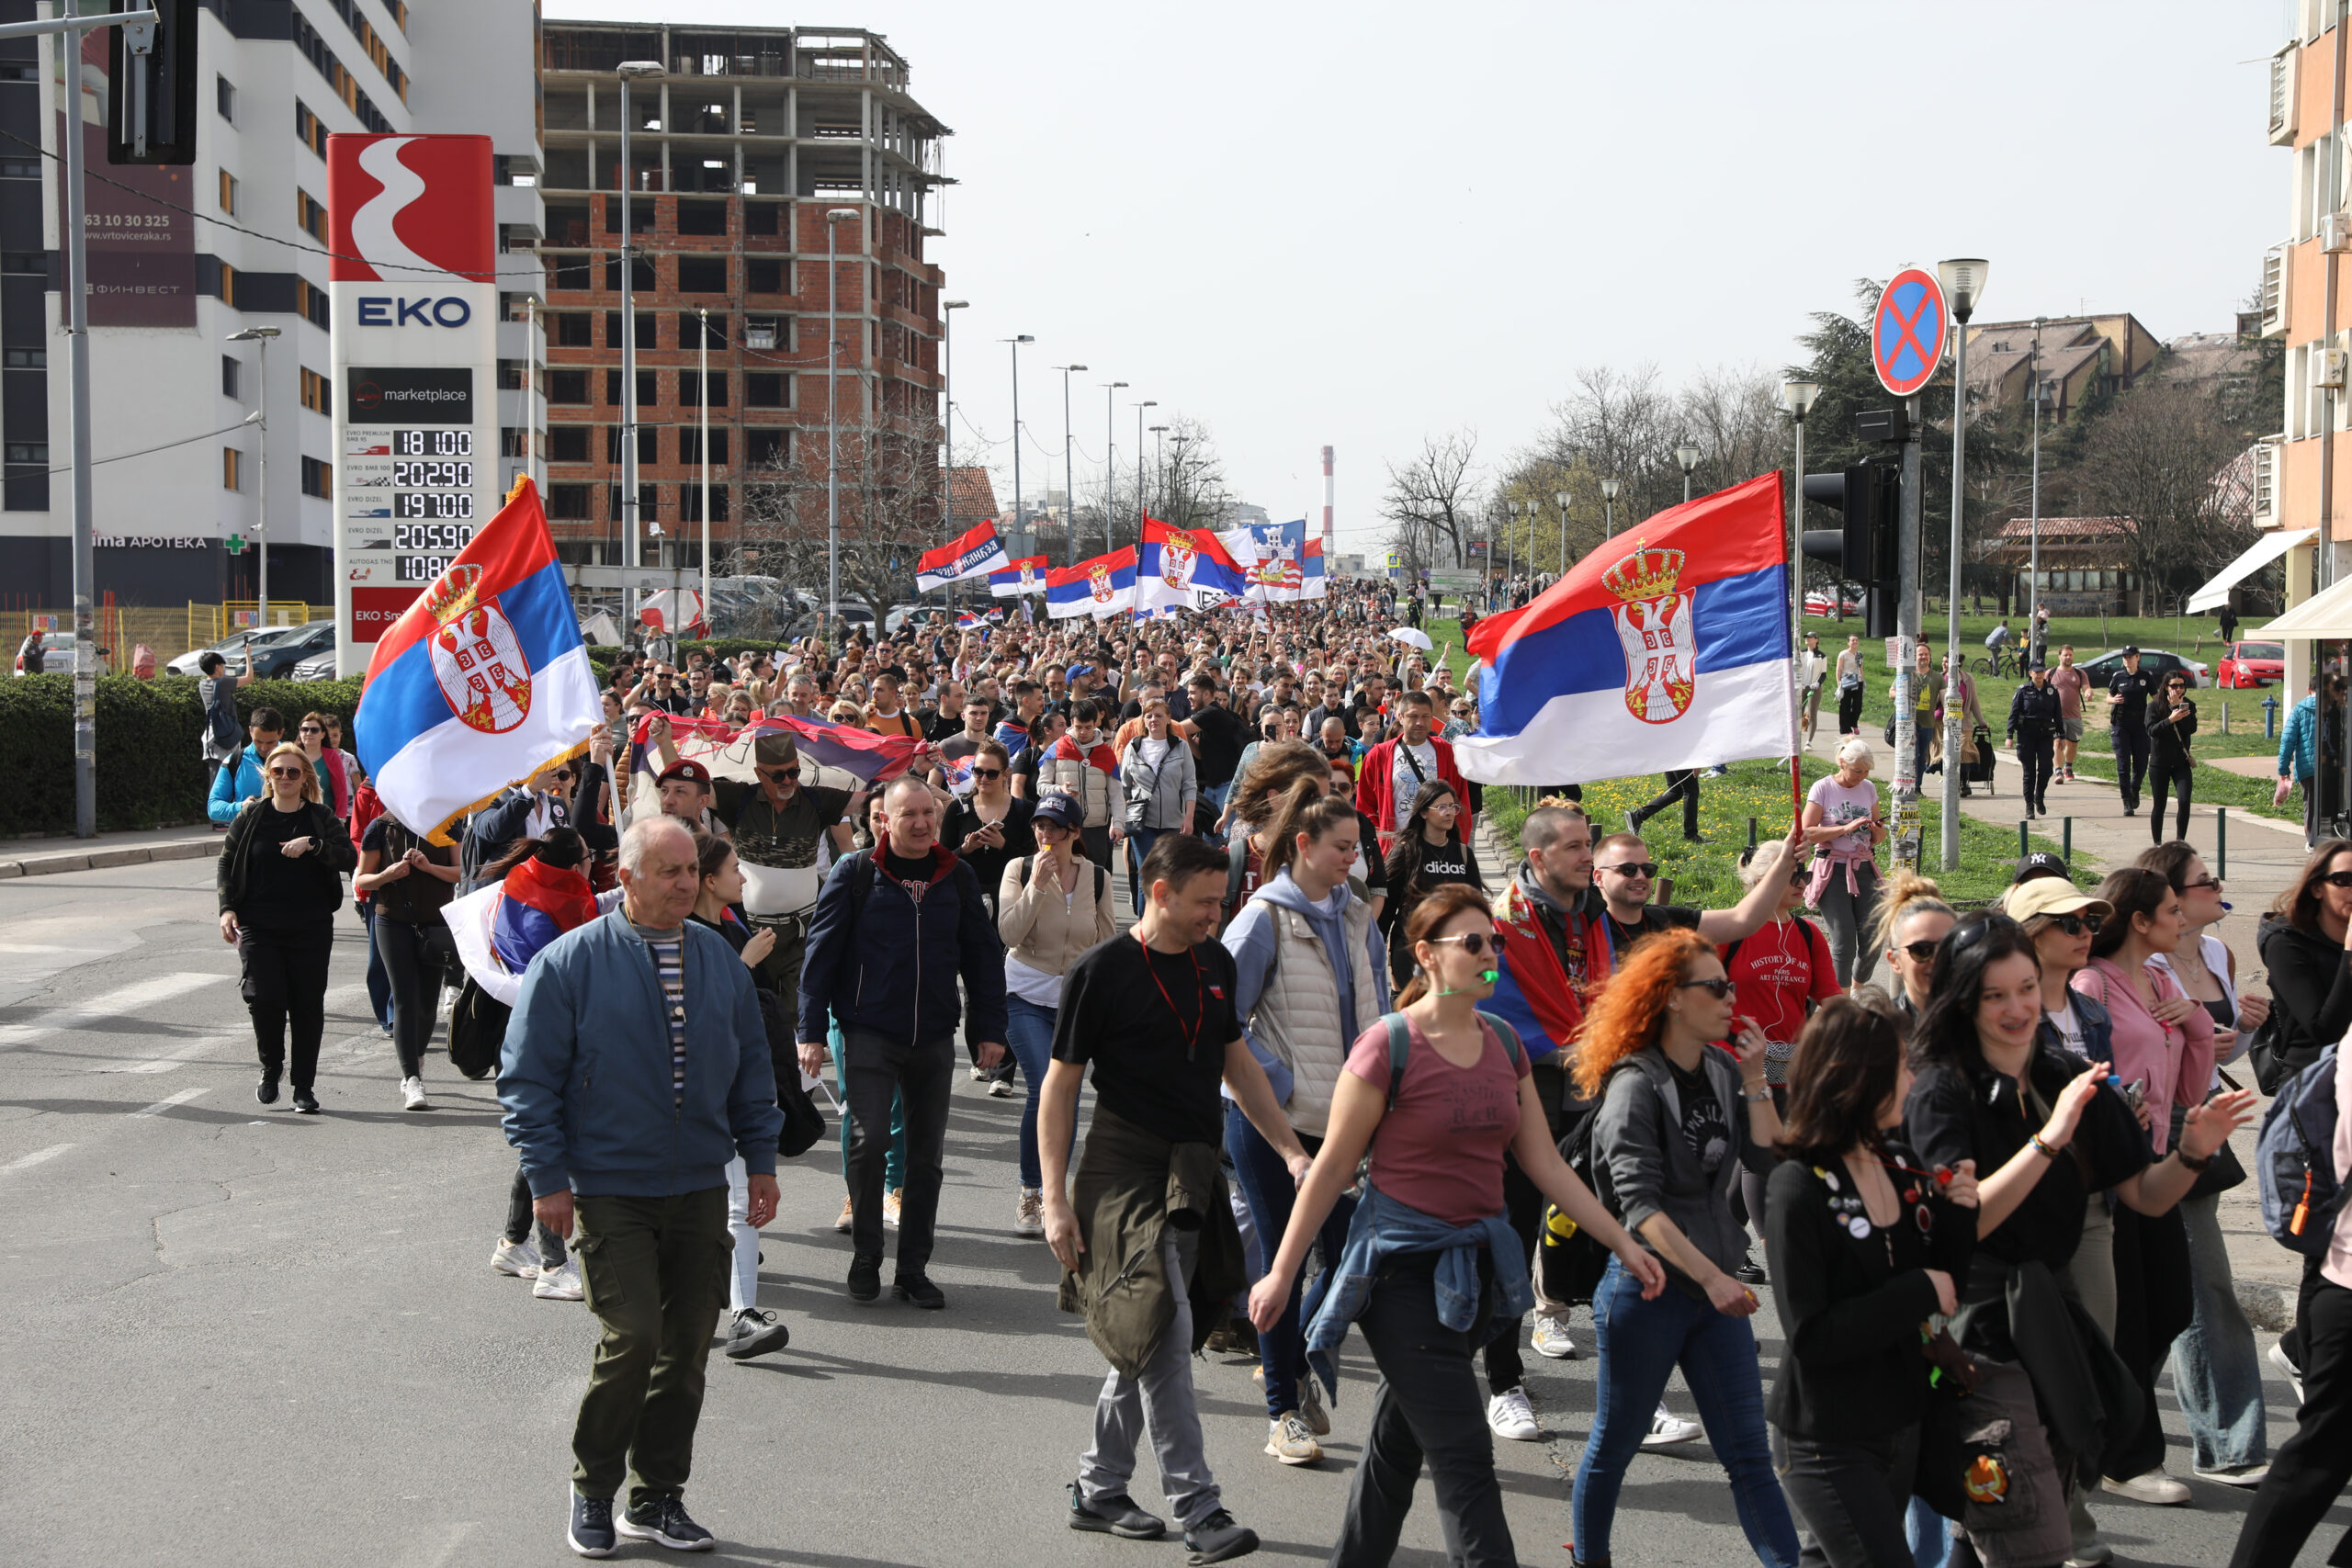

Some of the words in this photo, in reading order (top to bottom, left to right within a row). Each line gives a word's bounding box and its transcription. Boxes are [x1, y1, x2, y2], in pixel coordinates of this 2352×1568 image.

[105, 214, 121, 226] 10
[125, 215, 141, 226] 30
[144, 215, 170, 227] 325
[96, 286, 180, 294] ФИНВЕСТ
[357, 297, 471, 328] EKO
[384, 389, 467, 402] marketplace
[403, 431, 471, 456] 181.00
[394, 462, 472, 487] 202.90
[404, 494, 472, 518] 197.00
[130, 537, 207, 548] APOTEKA
[395, 525, 473, 549] 205.90
[356, 611, 381, 621] EKO
[1423, 861, 1466, 875] didas
[1750, 955, 1784, 970] HISTORY
[1786, 956, 1797, 965] OF
[1781, 975, 1806, 983] FRANCE
